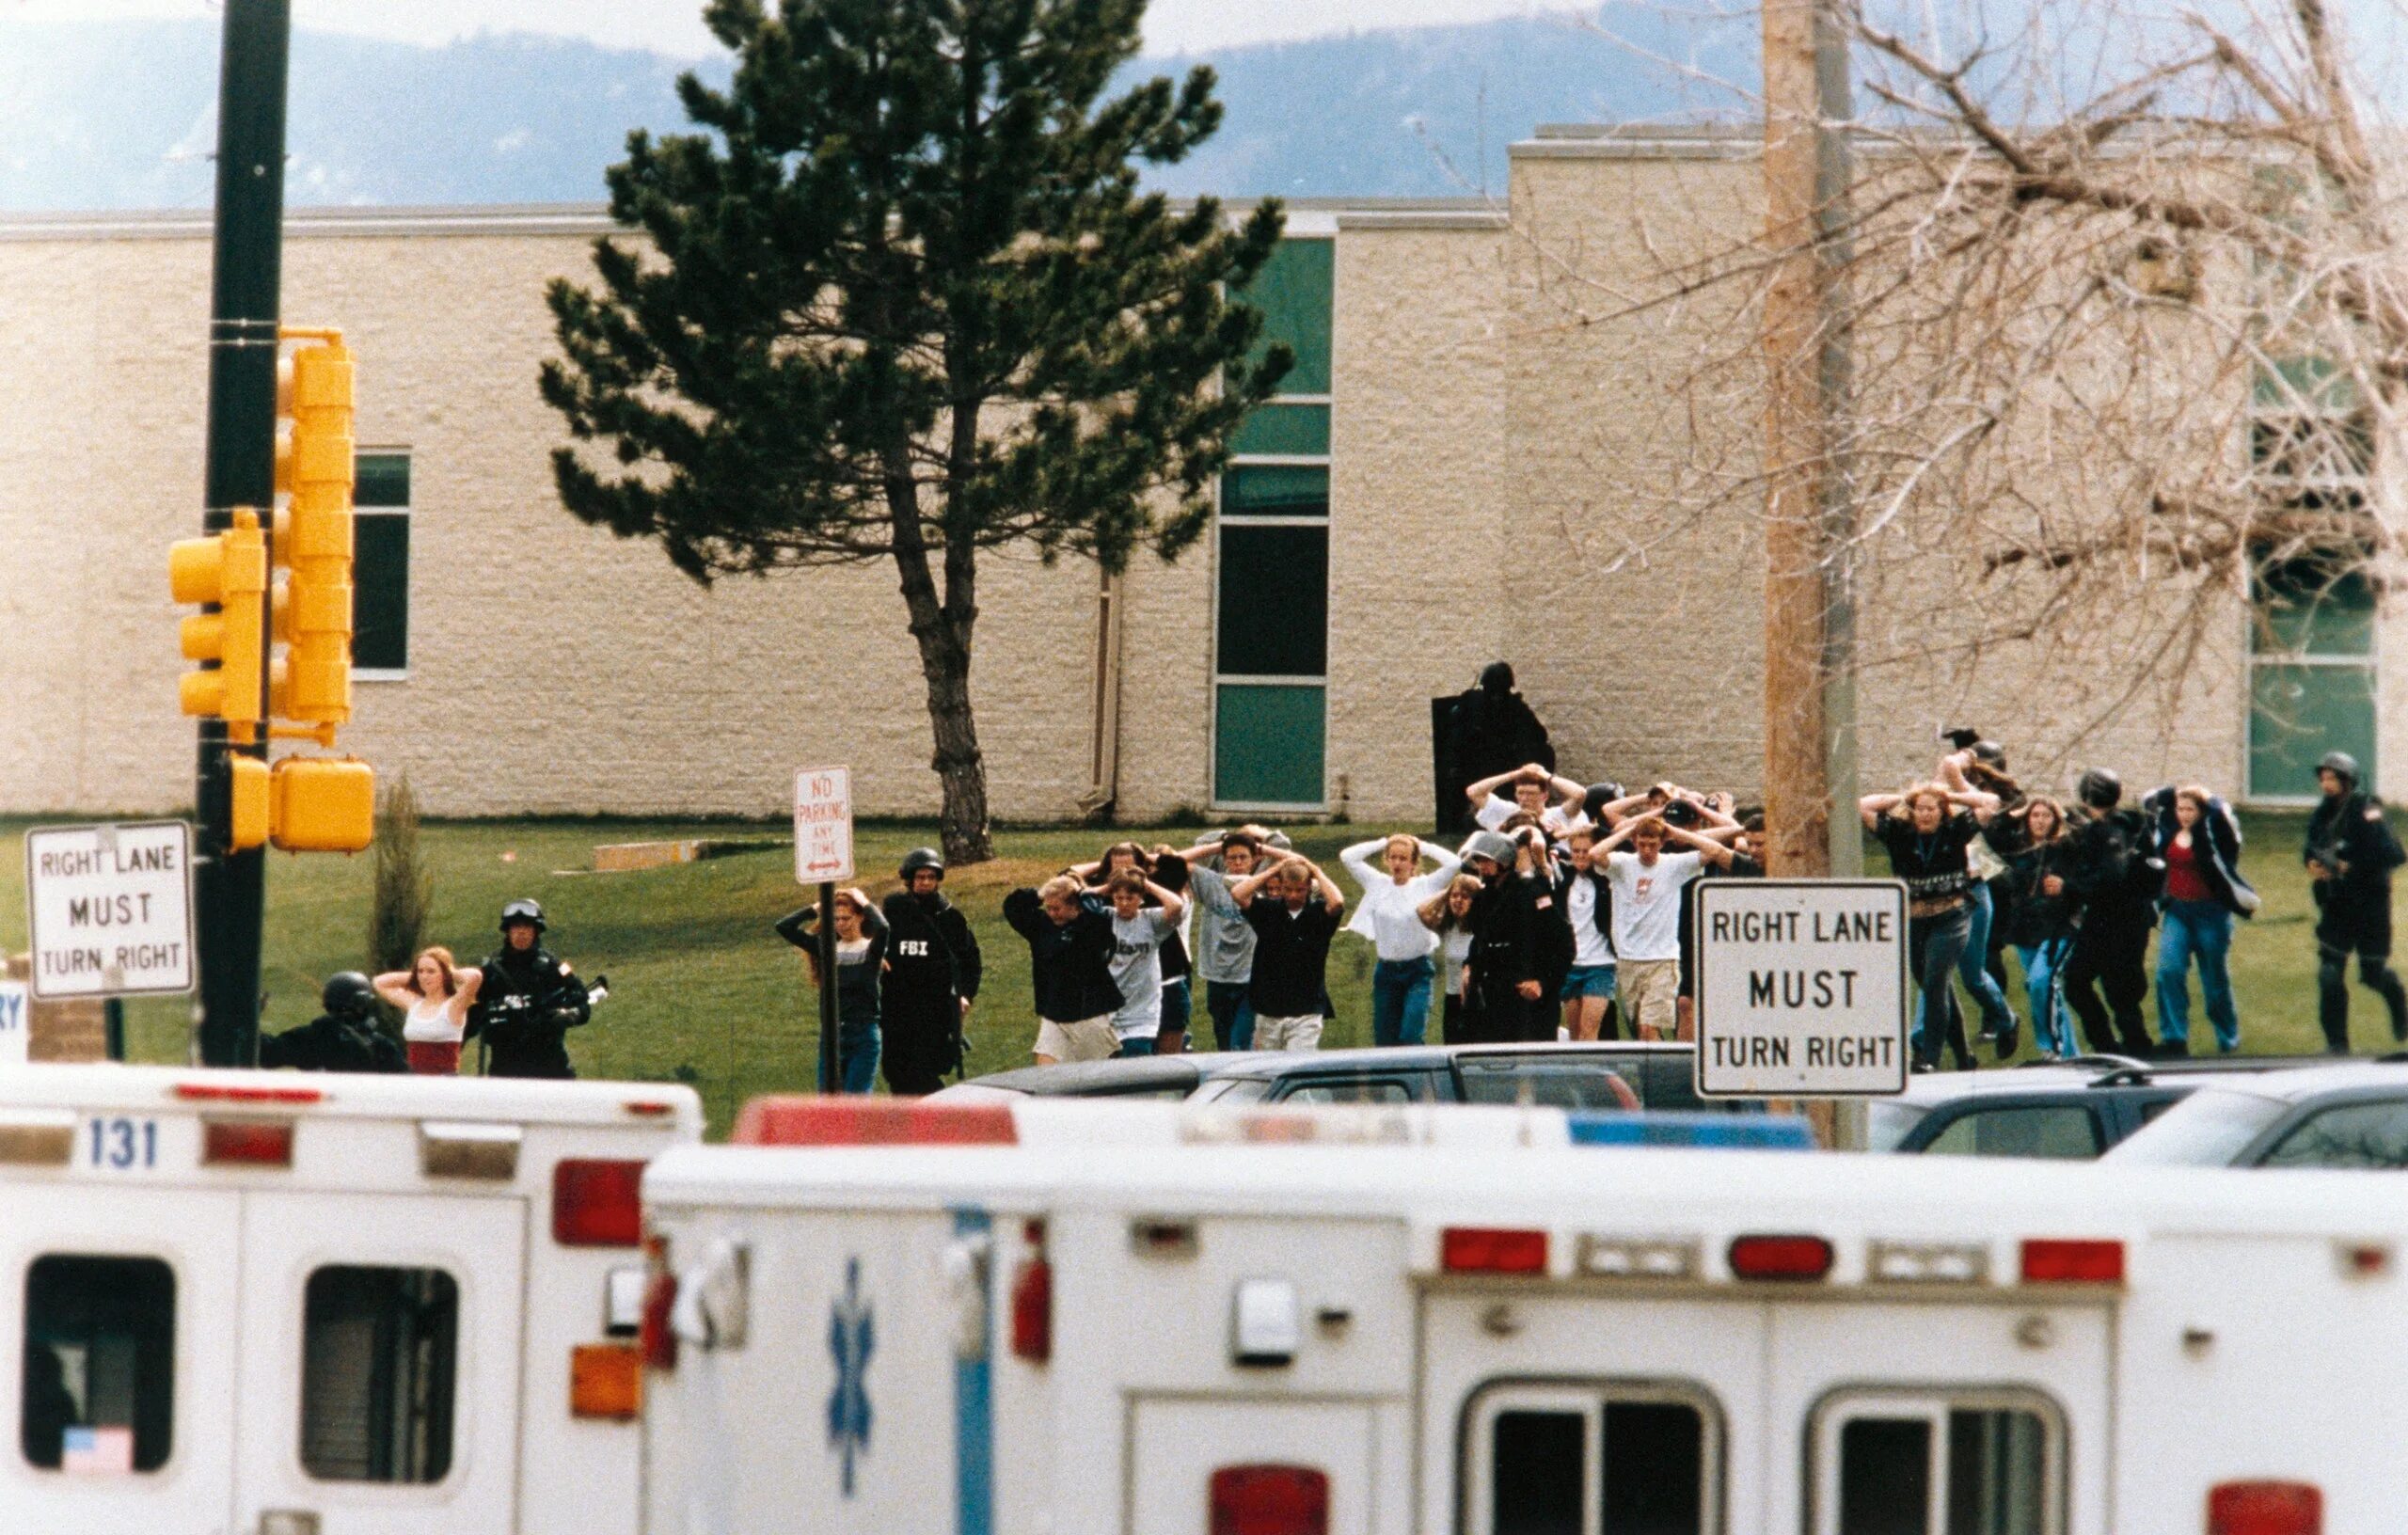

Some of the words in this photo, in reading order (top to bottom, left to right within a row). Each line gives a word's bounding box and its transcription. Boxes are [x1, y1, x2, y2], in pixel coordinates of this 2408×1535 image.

[812, 778, 832, 797] NO
[799, 801, 846, 821] PARKING
[813, 827, 832, 839] ANY
[40, 848, 103, 877] RIGHT
[115, 846, 175, 873] LANE
[812, 841, 835, 857] TIME
[69, 893, 151, 927] MUST
[1712, 911, 1800, 942] RIGHT
[1814, 911, 1893, 942] LANE
[42, 947, 102, 975] TURN
[115, 942, 180, 971] RIGHT
[899, 941, 928, 956] FBI
[1750, 970, 1858, 1008] MUST
[1712, 1037, 1791, 1068] TURN
[1806, 1037, 1896, 1068] RIGHT
[91, 1118, 156, 1167] 131
